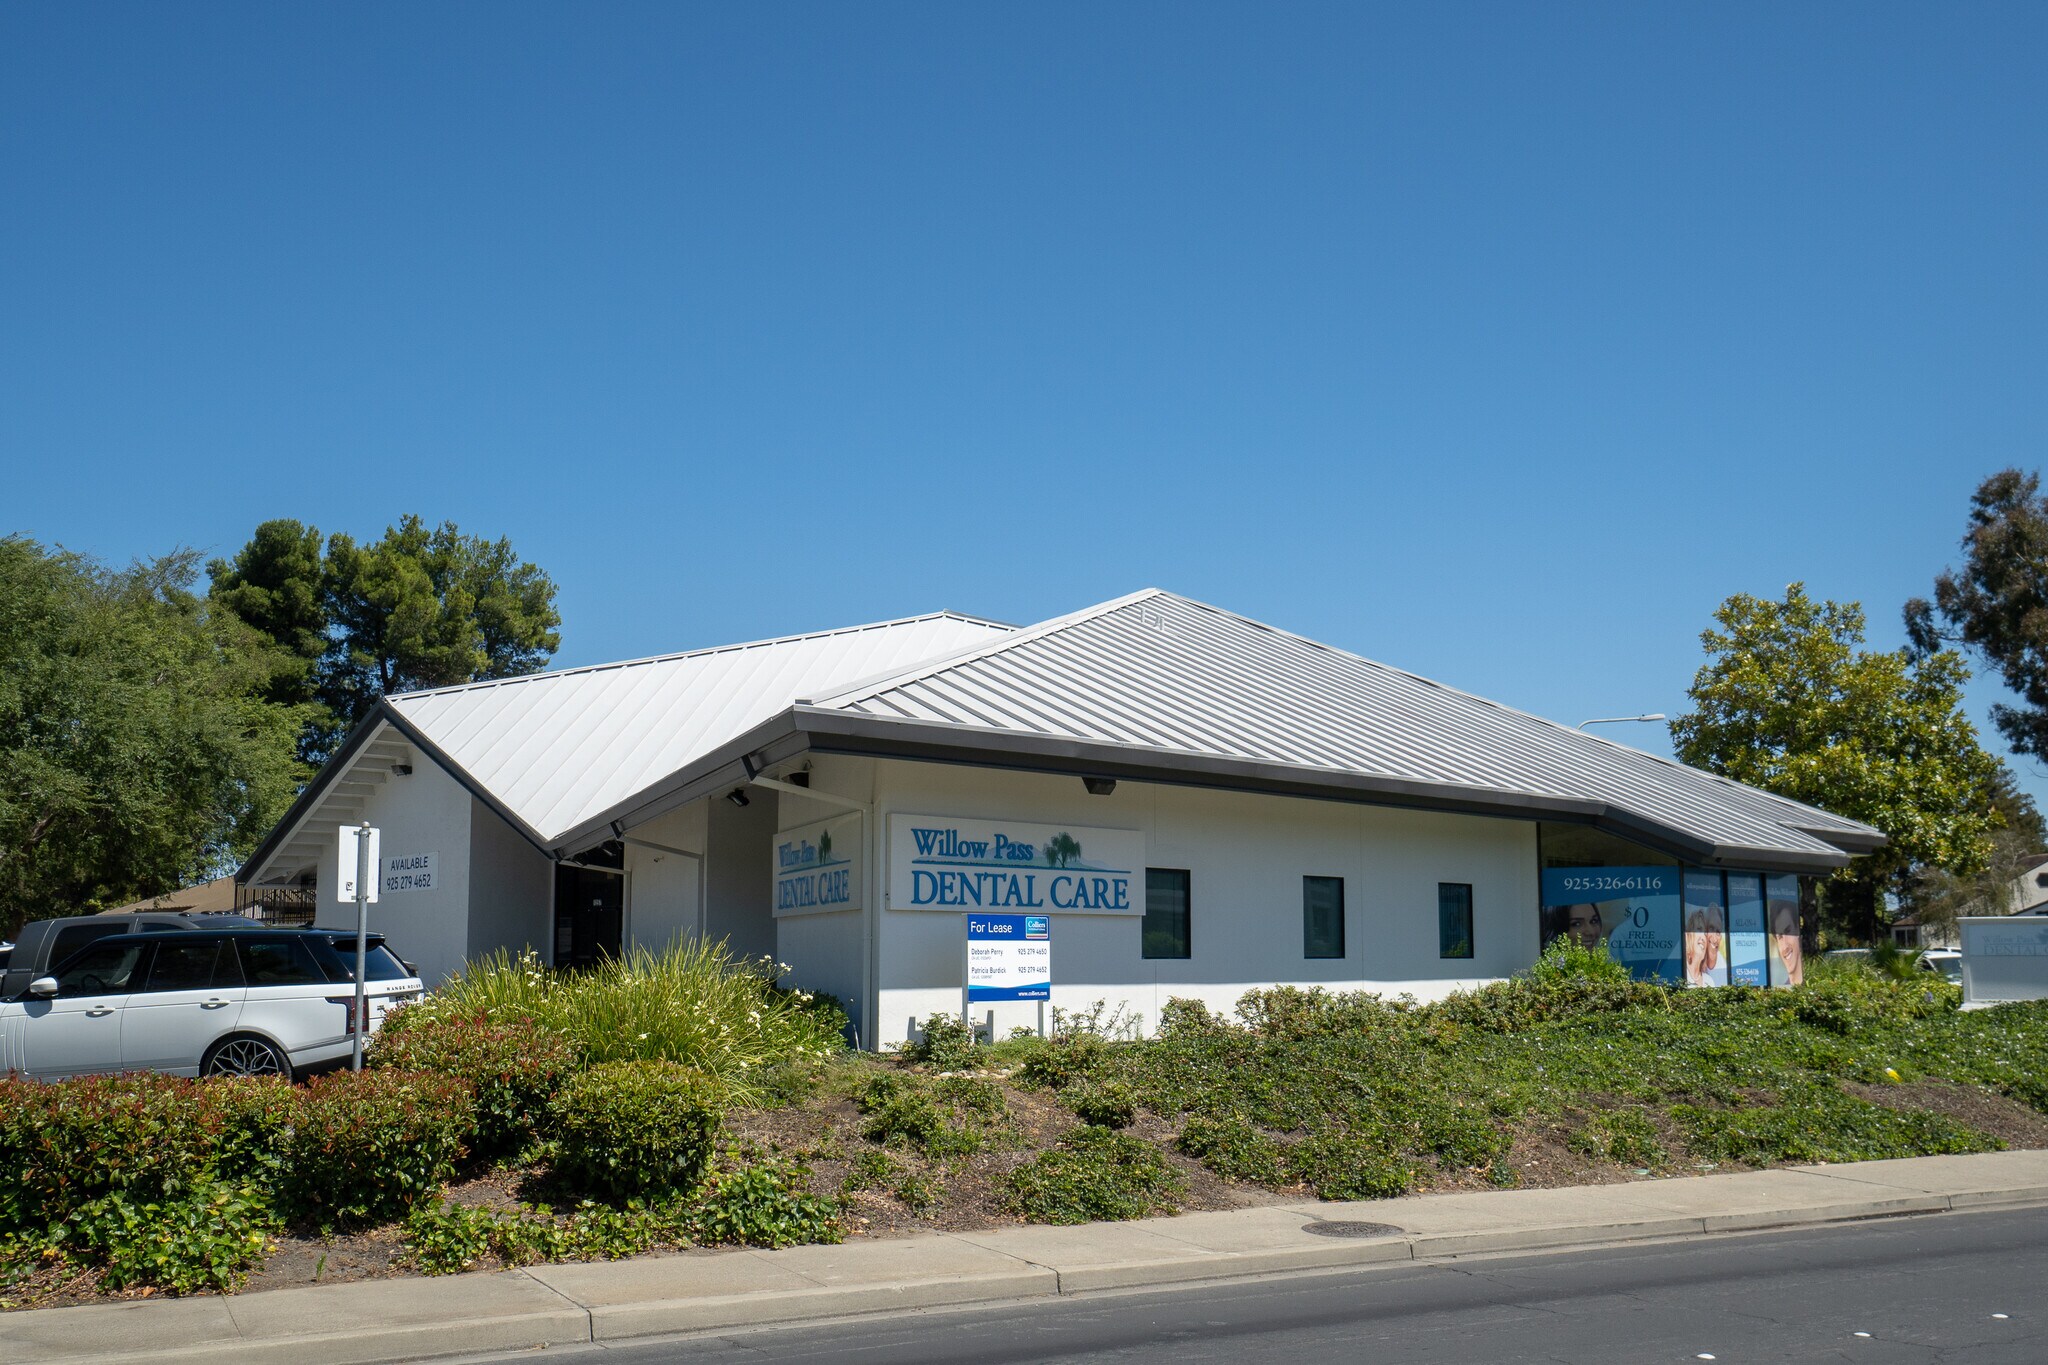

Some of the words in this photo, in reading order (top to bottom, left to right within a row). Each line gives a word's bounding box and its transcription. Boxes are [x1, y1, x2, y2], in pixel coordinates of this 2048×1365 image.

[911, 828, 989, 859] Willow
[994, 833, 1034, 861] Pass
[390, 856, 428, 871] AVAILABLE
[386, 877, 399, 890] 925
[400, 875, 413, 889] 279
[414, 873, 431, 888] 4652
[1563, 876, 1662, 890] 925-326-6116
[778, 875, 817, 909] DENTAL
[818, 869, 850, 905] CARE
[911, 870, 1044, 907] DENTAL
[1050, 876, 1130, 910] CARE
[970, 921, 985, 932] For
[988, 922, 1012, 933] Lease
[1628, 931, 1656, 940] FREE
[1610, 940, 1673, 950] CLEANINGS
[1983, 944, 2038, 955] DENTAL
[971, 948, 990, 956] Deborah
[991, 948, 1003, 957] Perry
[971, 966, 989, 974] Patricia
[990, 966, 1006, 974] Burdick
